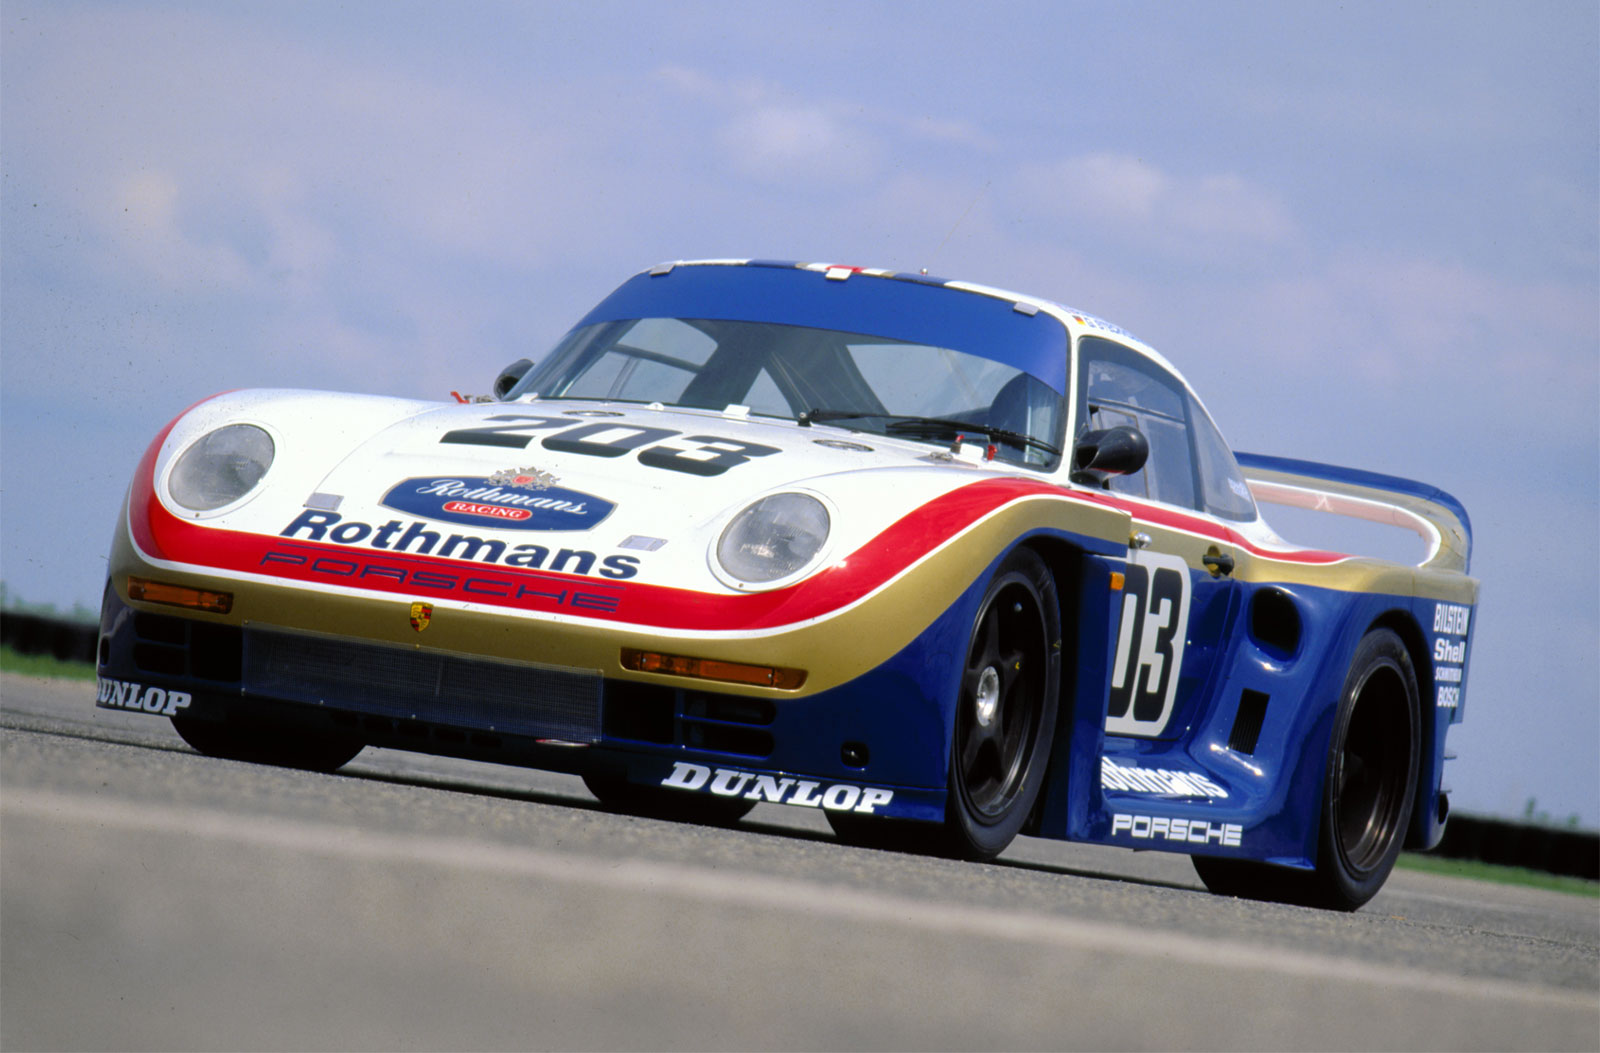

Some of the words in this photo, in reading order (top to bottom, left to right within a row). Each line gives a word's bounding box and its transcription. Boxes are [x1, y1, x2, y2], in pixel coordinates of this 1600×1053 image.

[439, 415, 783, 477] 203
[416, 479, 588, 515] Rothmans
[450, 503, 524, 519] RACING
[280, 509, 641, 580] Rothmans
[259, 551, 621, 613] PORSCHE
[1434, 638, 1466, 663] Shell
[1437, 686, 1461, 708] BOSCH
[661, 761, 894, 814] DUNLOP
[1111, 813, 1243, 847] PORSCHE
